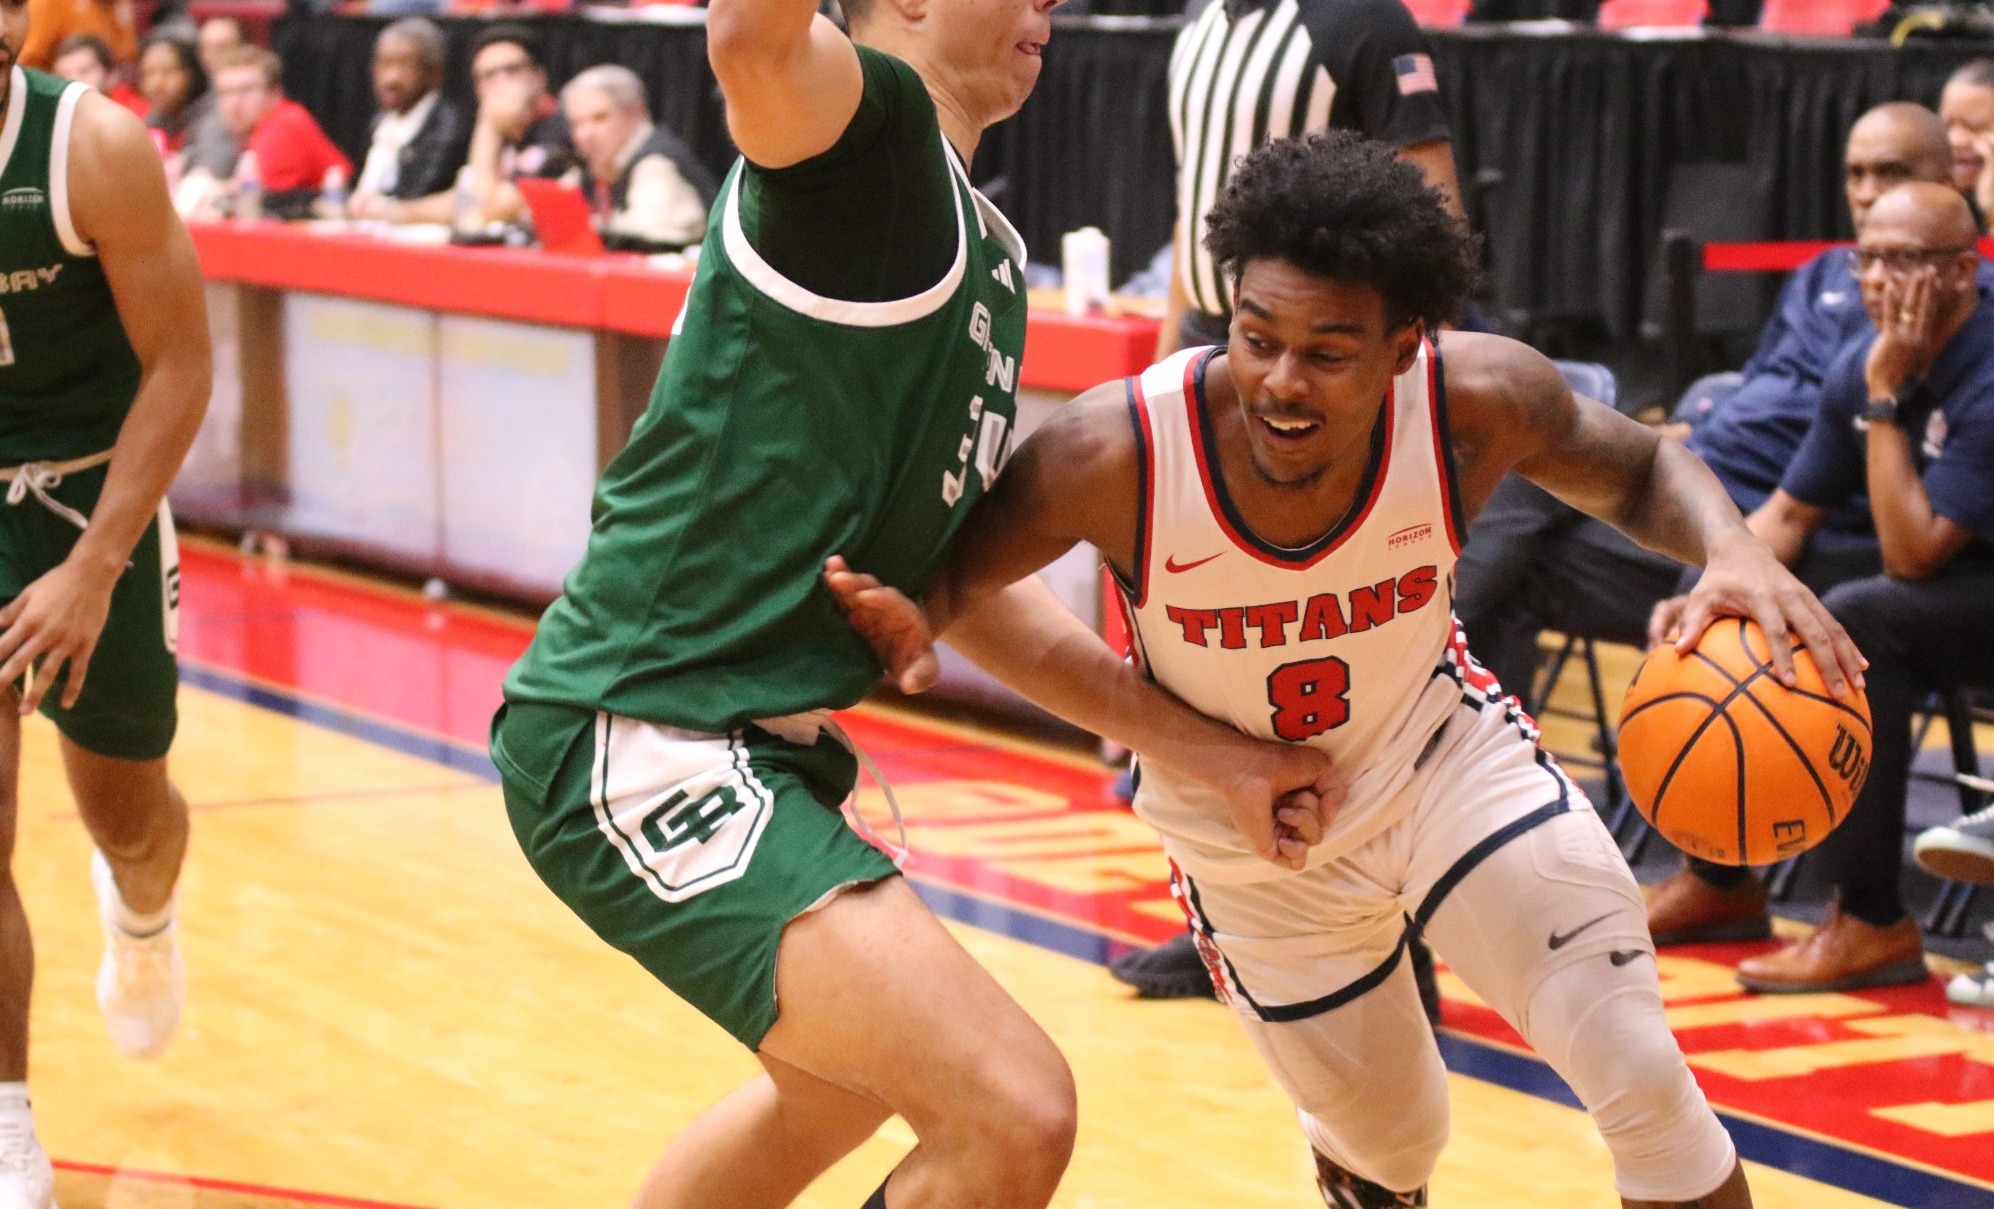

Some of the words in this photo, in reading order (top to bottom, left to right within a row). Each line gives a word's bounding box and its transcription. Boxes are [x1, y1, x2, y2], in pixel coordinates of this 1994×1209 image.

[1388, 526, 1432, 546] HORIZON
[1165, 565, 1437, 649] TITANS
[1266, 655, 1350, 742] 8
